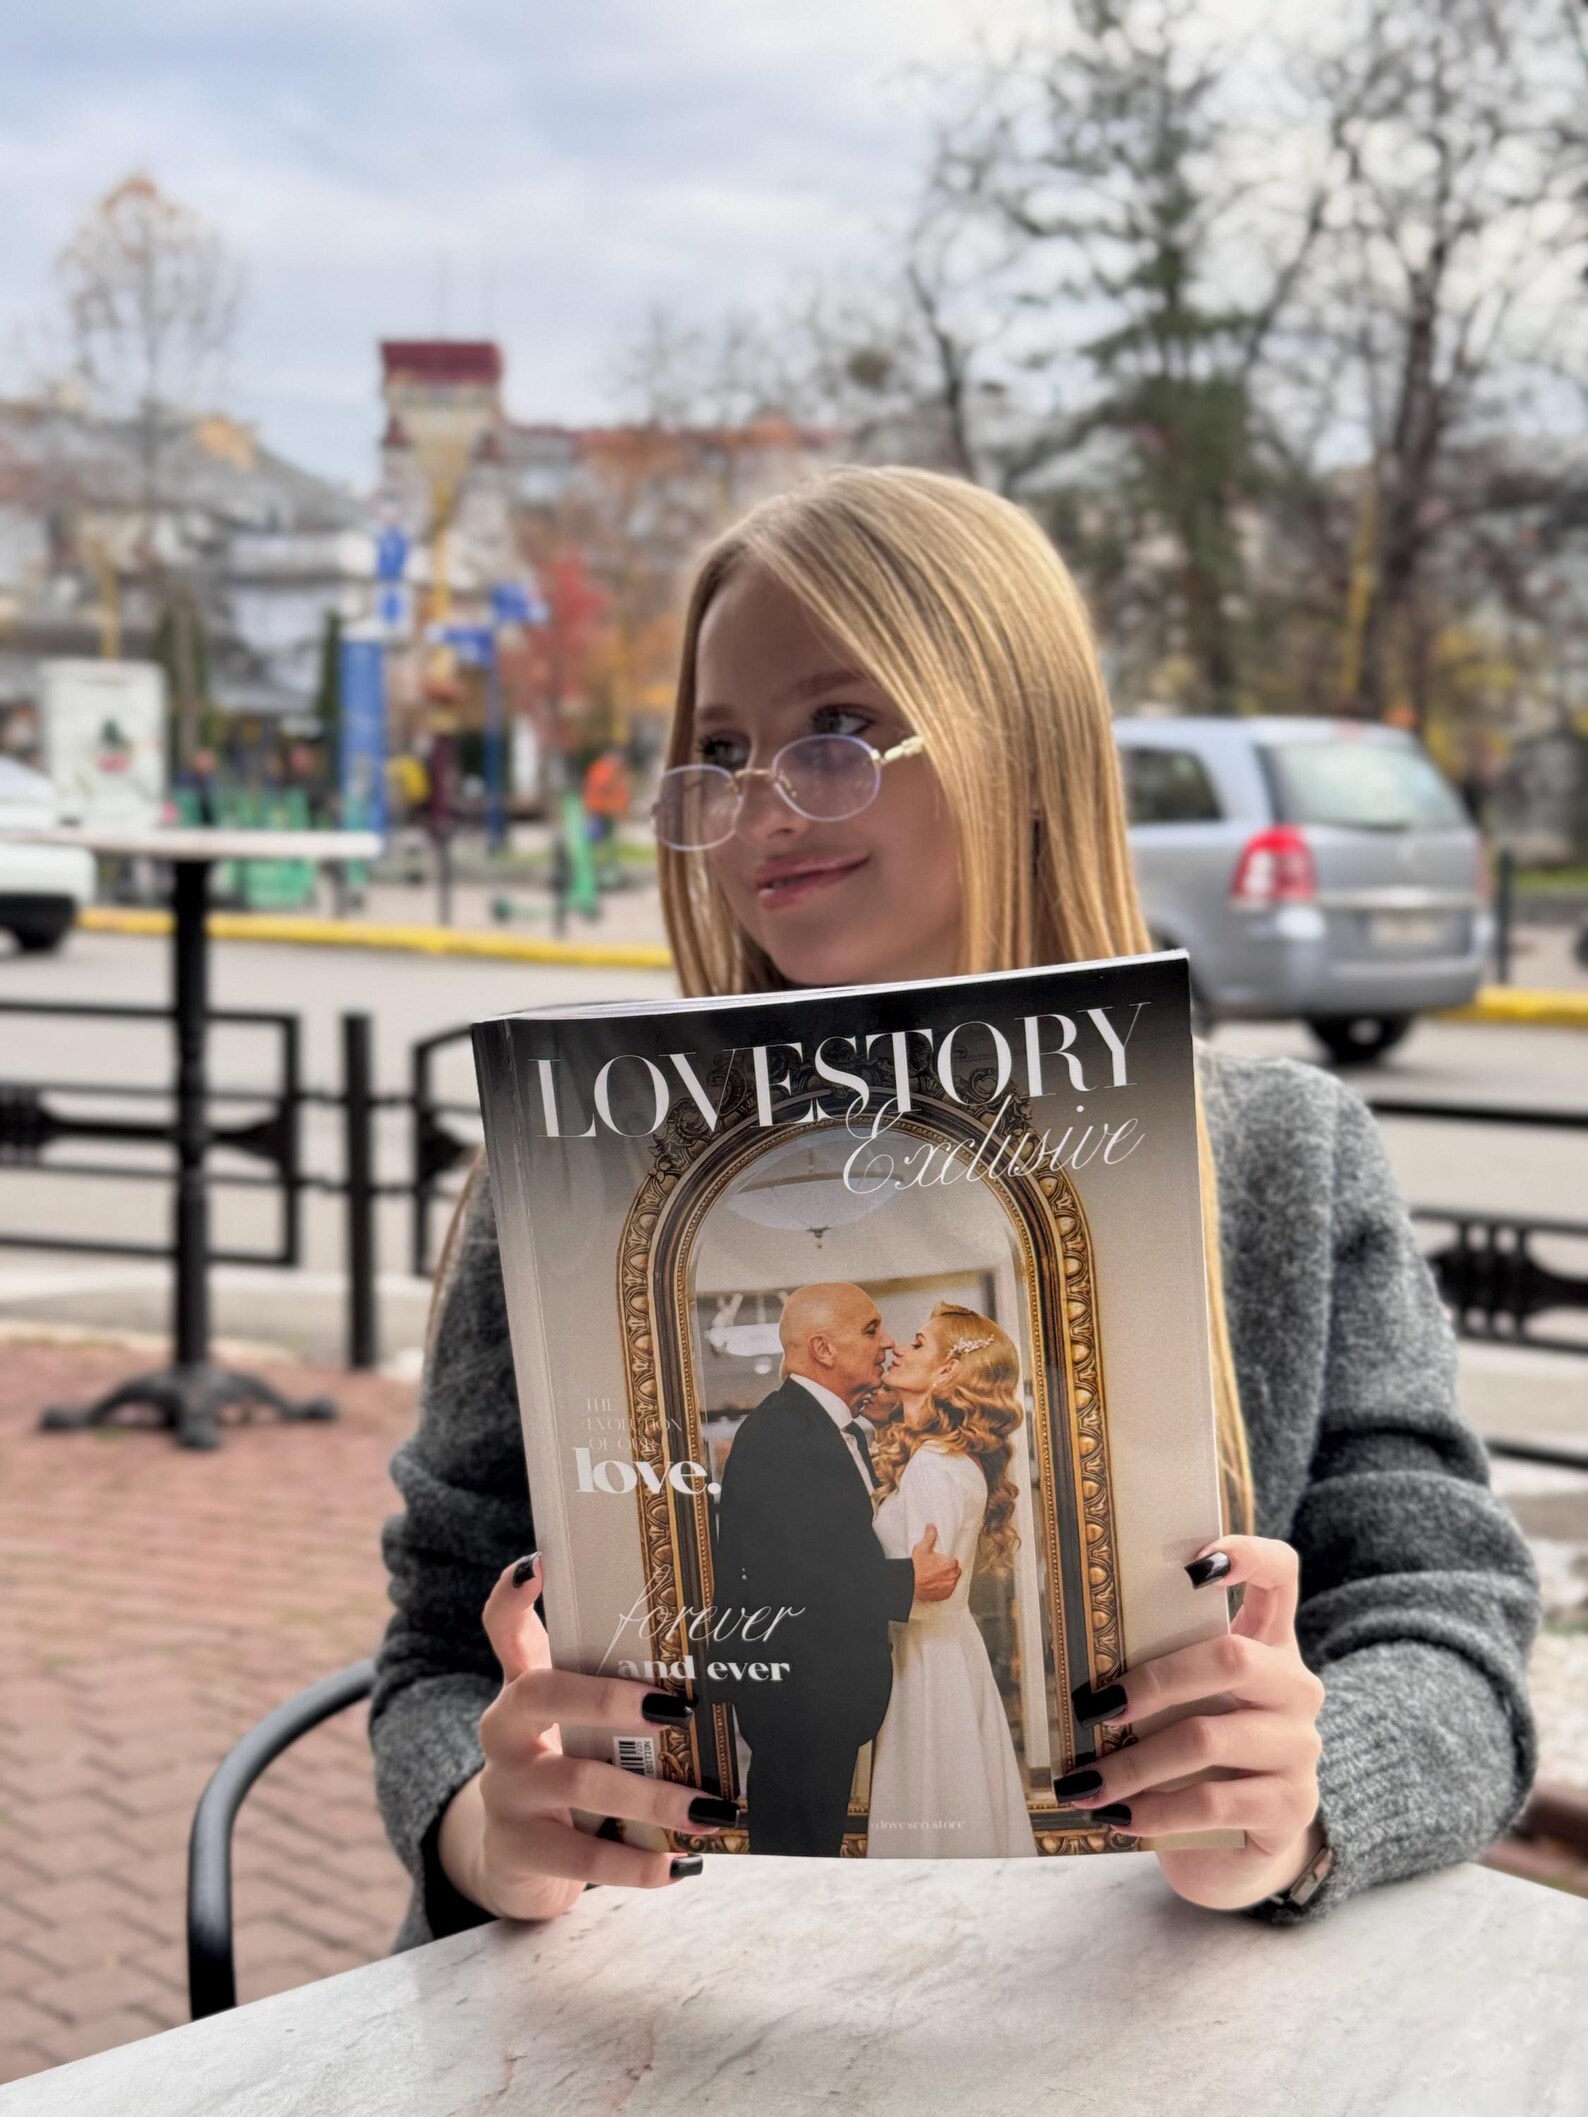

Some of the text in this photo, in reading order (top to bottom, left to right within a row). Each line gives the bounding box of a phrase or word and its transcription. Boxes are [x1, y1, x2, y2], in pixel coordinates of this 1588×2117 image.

[528, 1001, 1152, 1138] LOVESTORY
[842, 1094, 1147, 1194] Exclusive
[571, 1446, 722, 1495] love.
[596, 1564, 806, 1676] forever
[617, 1655, 791, 1682] and ever
[643, 1740, 655, 1774] EDITION
